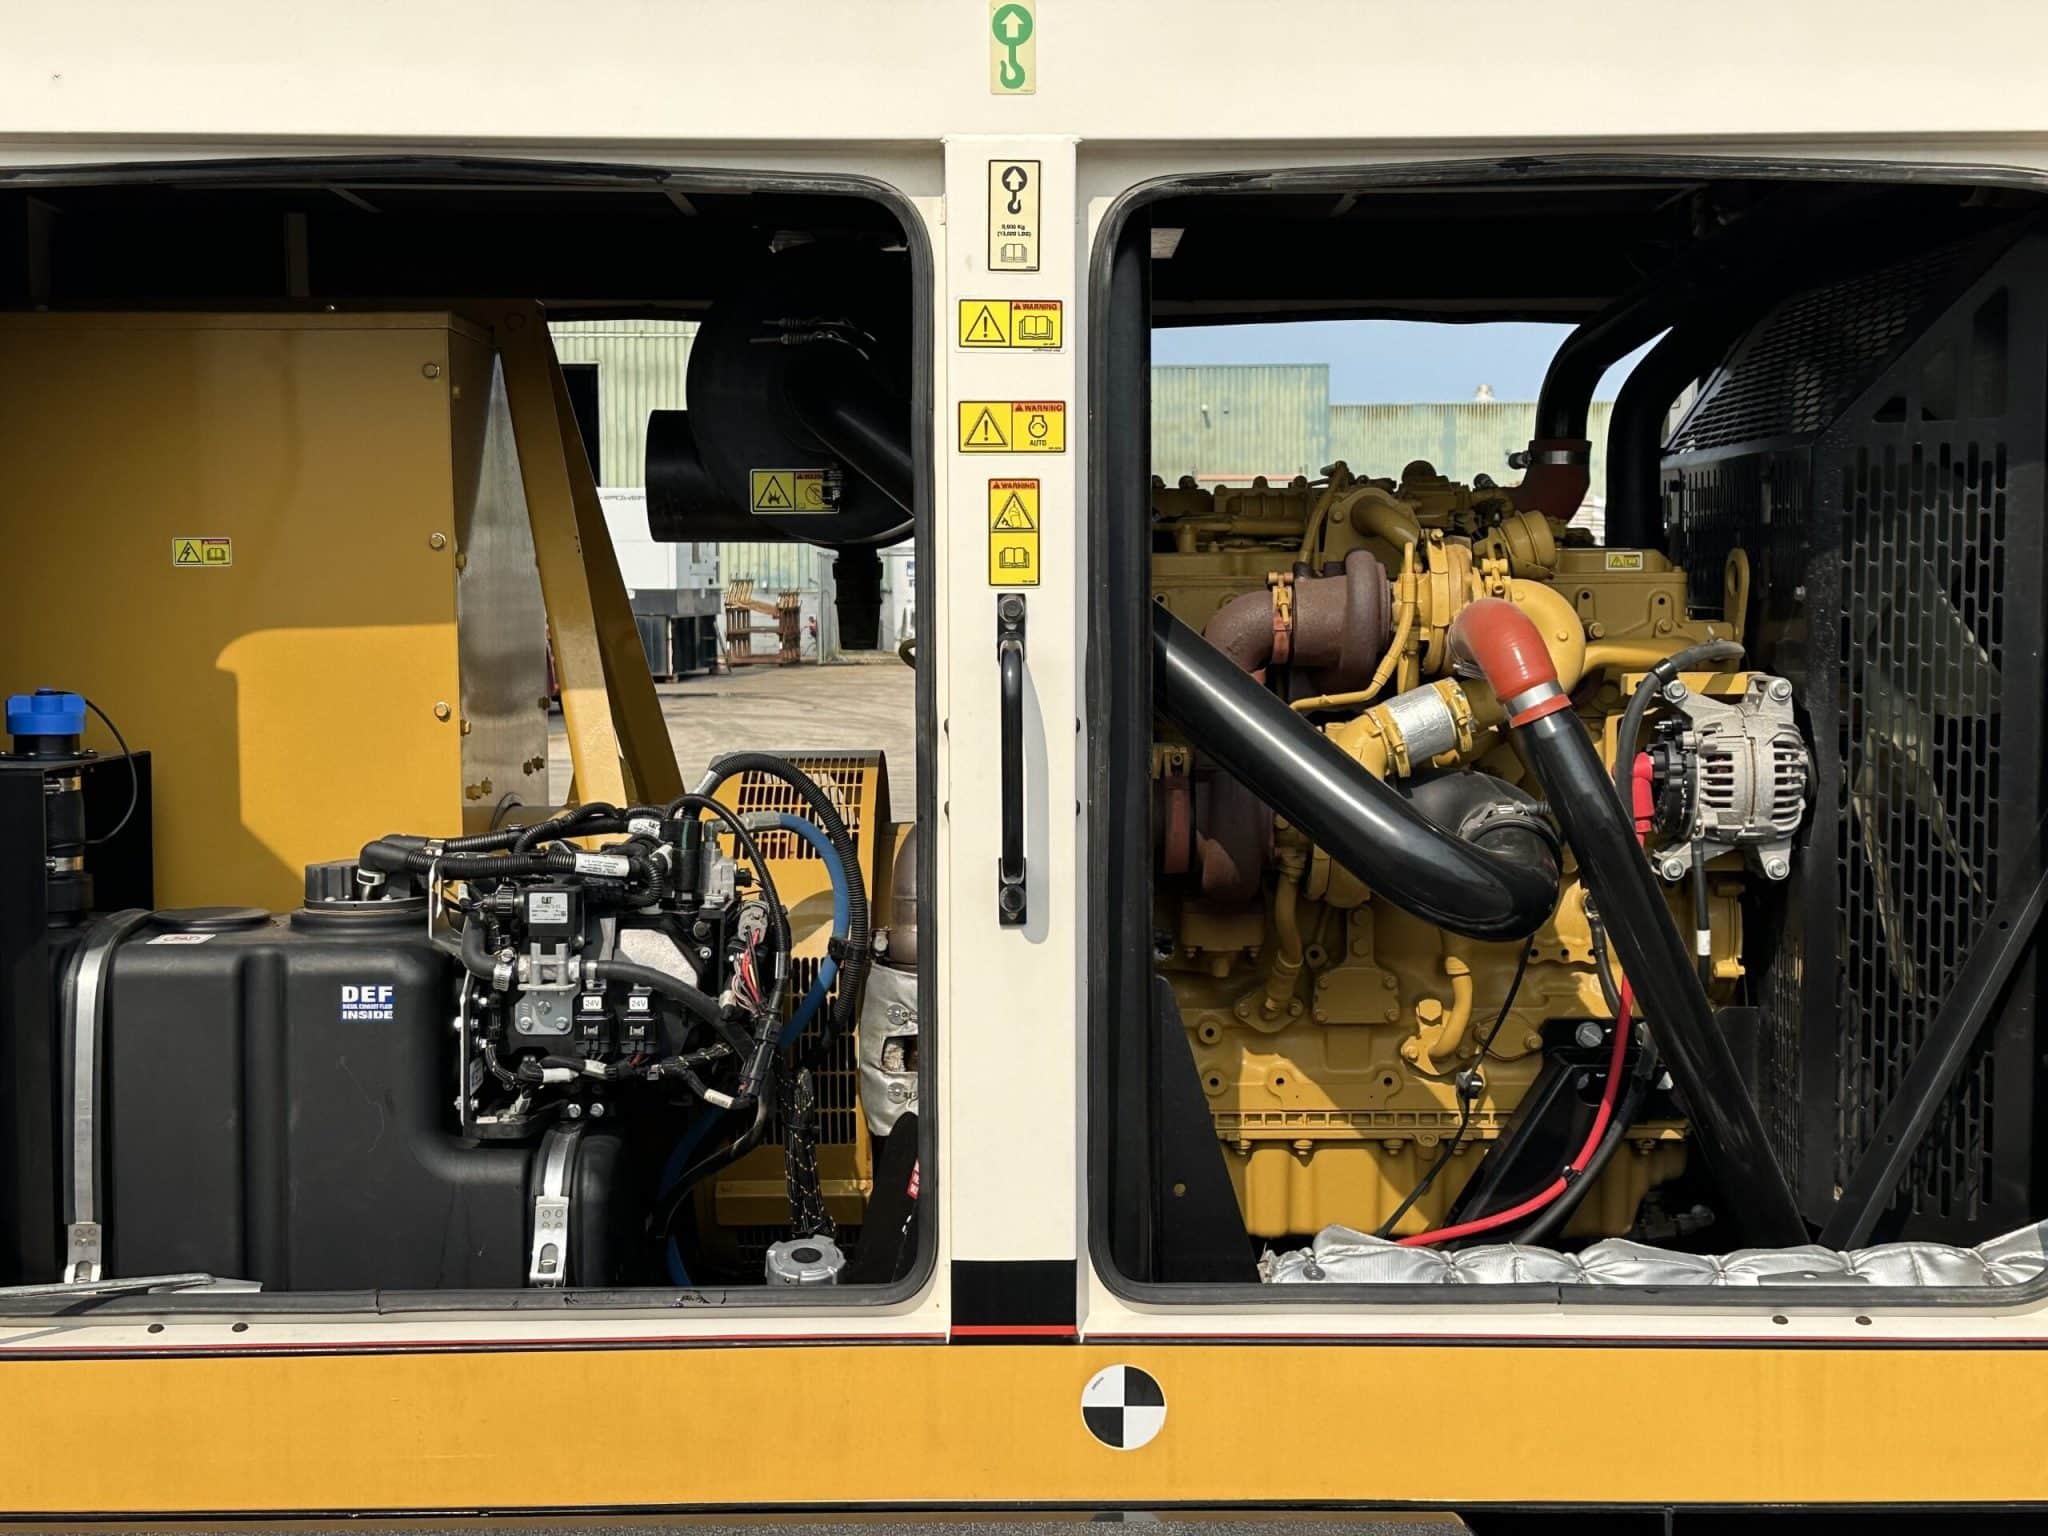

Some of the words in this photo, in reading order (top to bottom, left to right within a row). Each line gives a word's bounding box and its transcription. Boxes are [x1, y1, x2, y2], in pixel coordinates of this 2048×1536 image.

[1022, 303, 1058, 311] WARNING
[1024, 404, 1063, 412] WARNING
[1029, 439, 1047, 447] AUTO
[342, 986, 393, 1002] DEF
[585, 999, 600, 1007] 24V
[631, 999, 646, 1007] 24V
[342, 1010, 393, 1020] INSIDE
